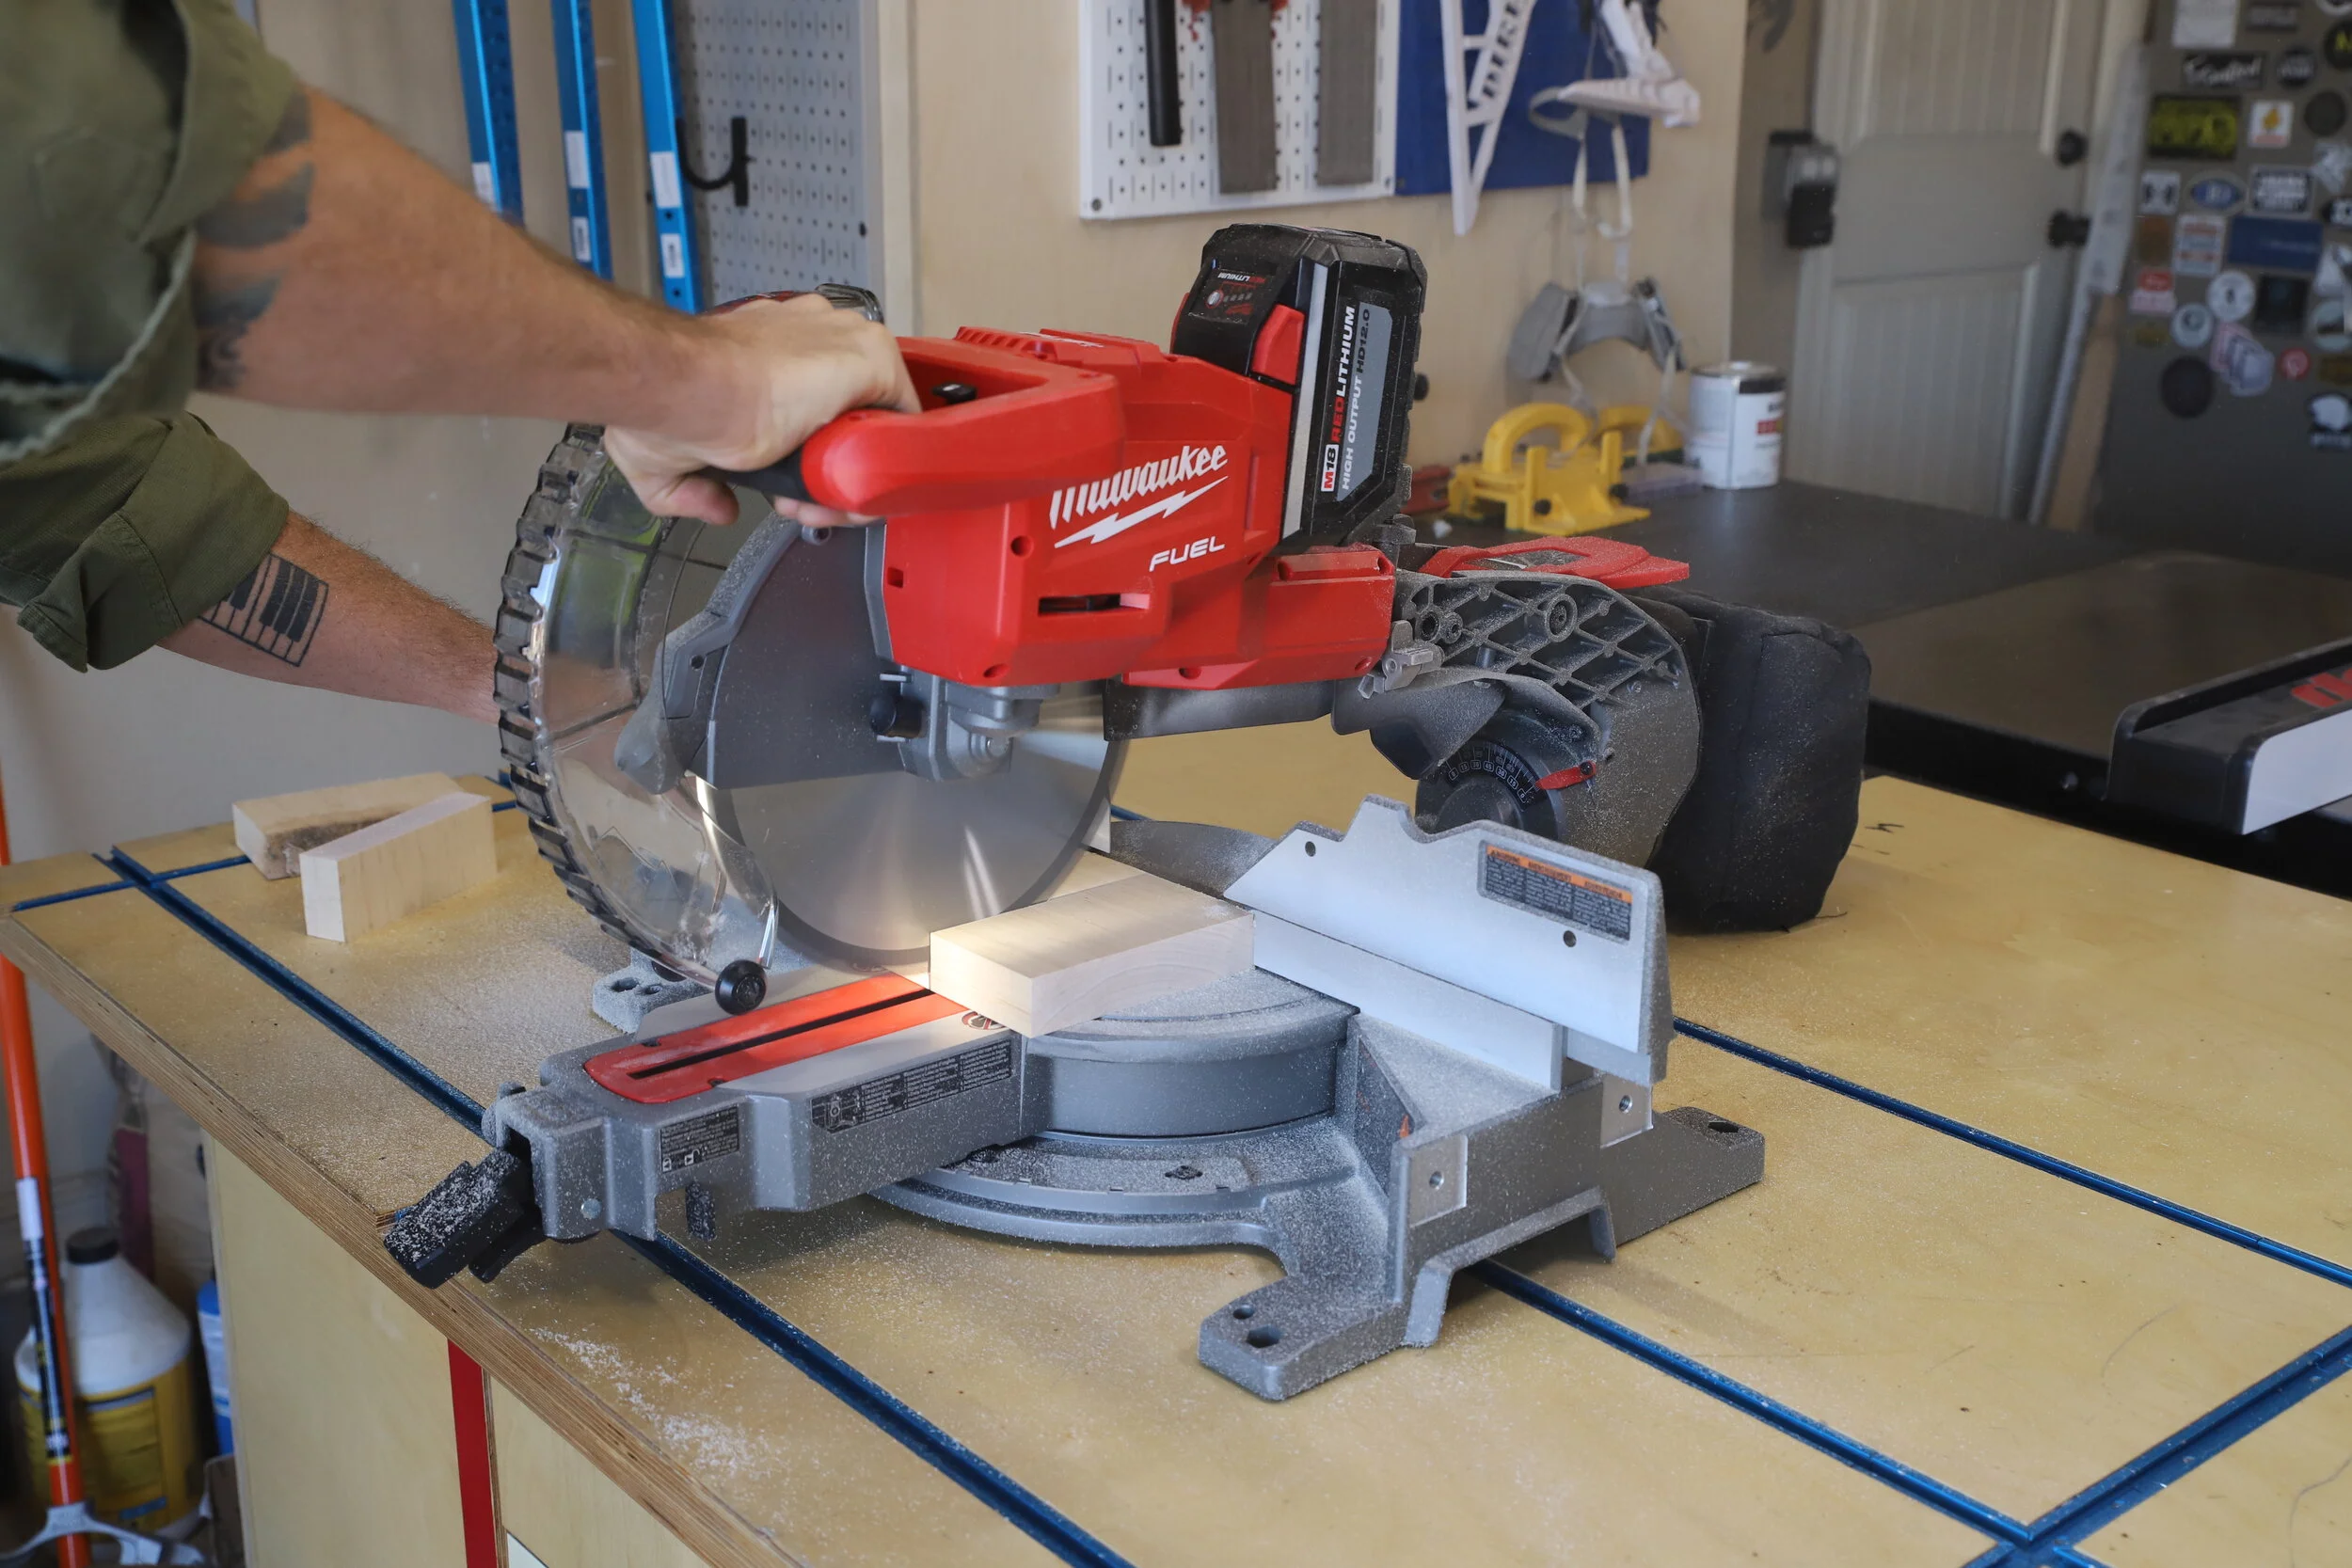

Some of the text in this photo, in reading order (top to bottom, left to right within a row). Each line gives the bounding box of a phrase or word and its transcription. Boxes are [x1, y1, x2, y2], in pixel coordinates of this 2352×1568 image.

[1323, 306, 1356, 490] M18 REDLITHIUM
[1342, 309, 1371, 490] HIGH OUTPUT HD12.0
[1049, 445, 1229, 531] Milwaukee
[1149, 535, 1225, 572] FUEL
